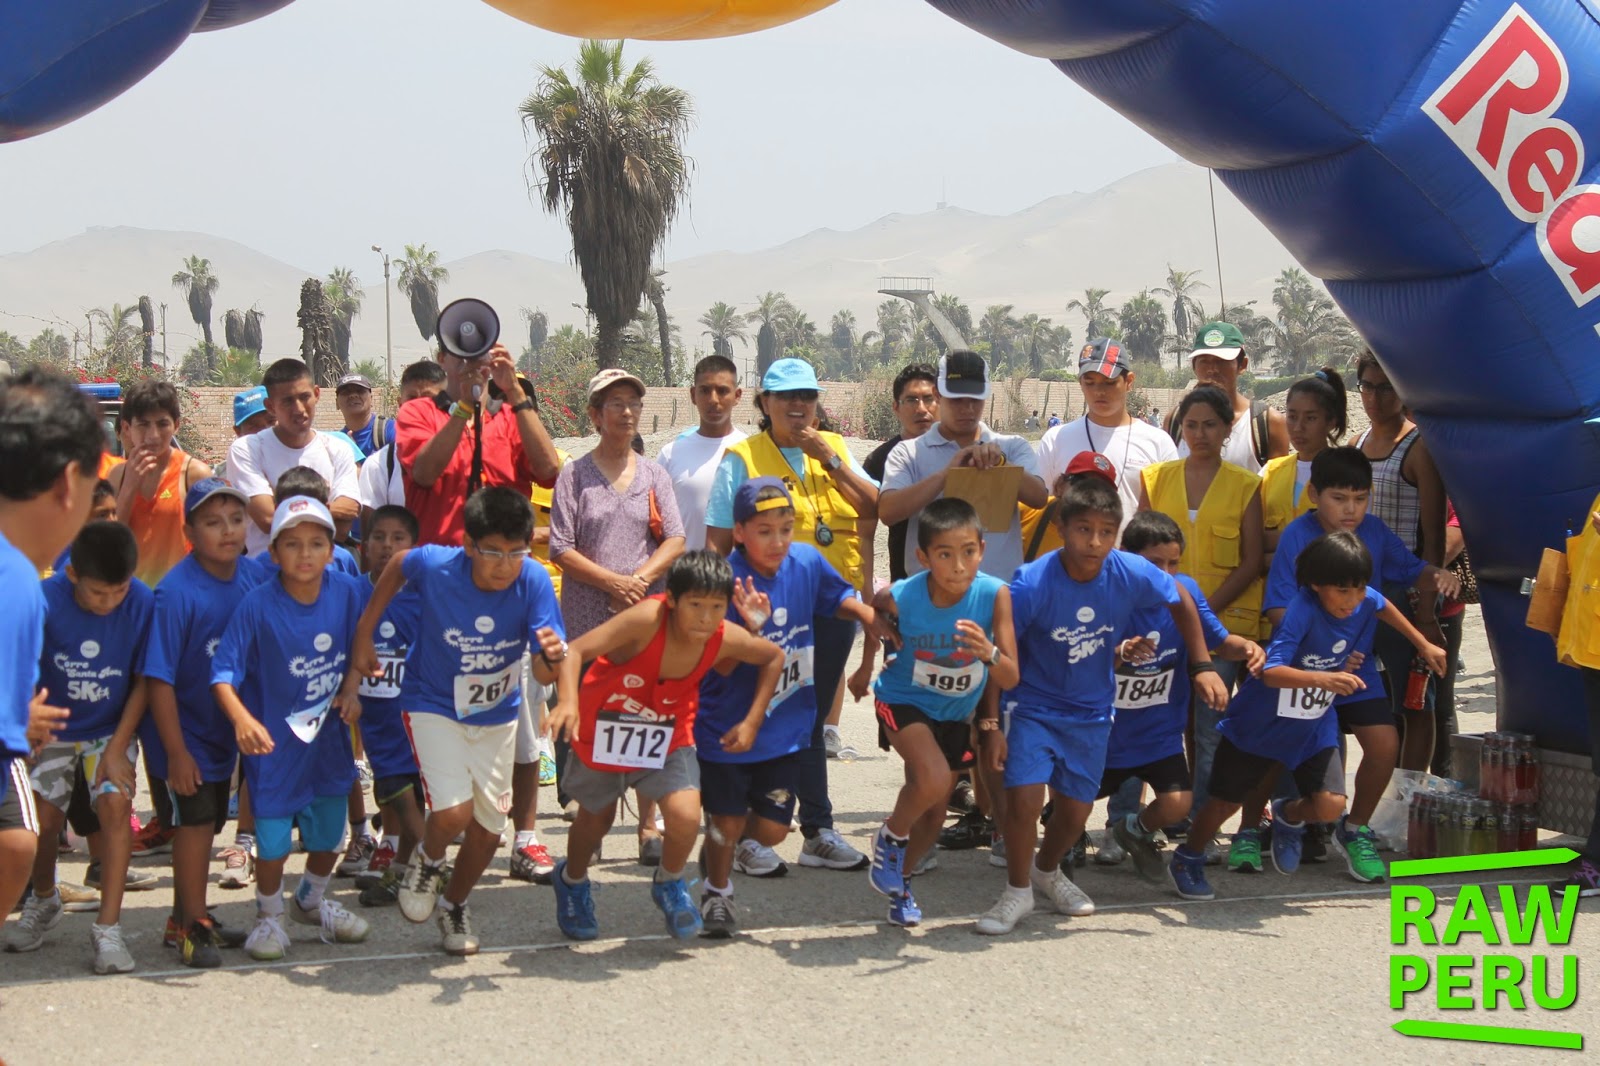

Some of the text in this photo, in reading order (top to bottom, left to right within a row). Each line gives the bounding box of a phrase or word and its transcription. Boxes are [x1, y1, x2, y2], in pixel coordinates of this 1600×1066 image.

[926, 673, 972, 692] 199
[1118, 674, 1169, 702] 1844
[603, 725, 667, 759] 1712
